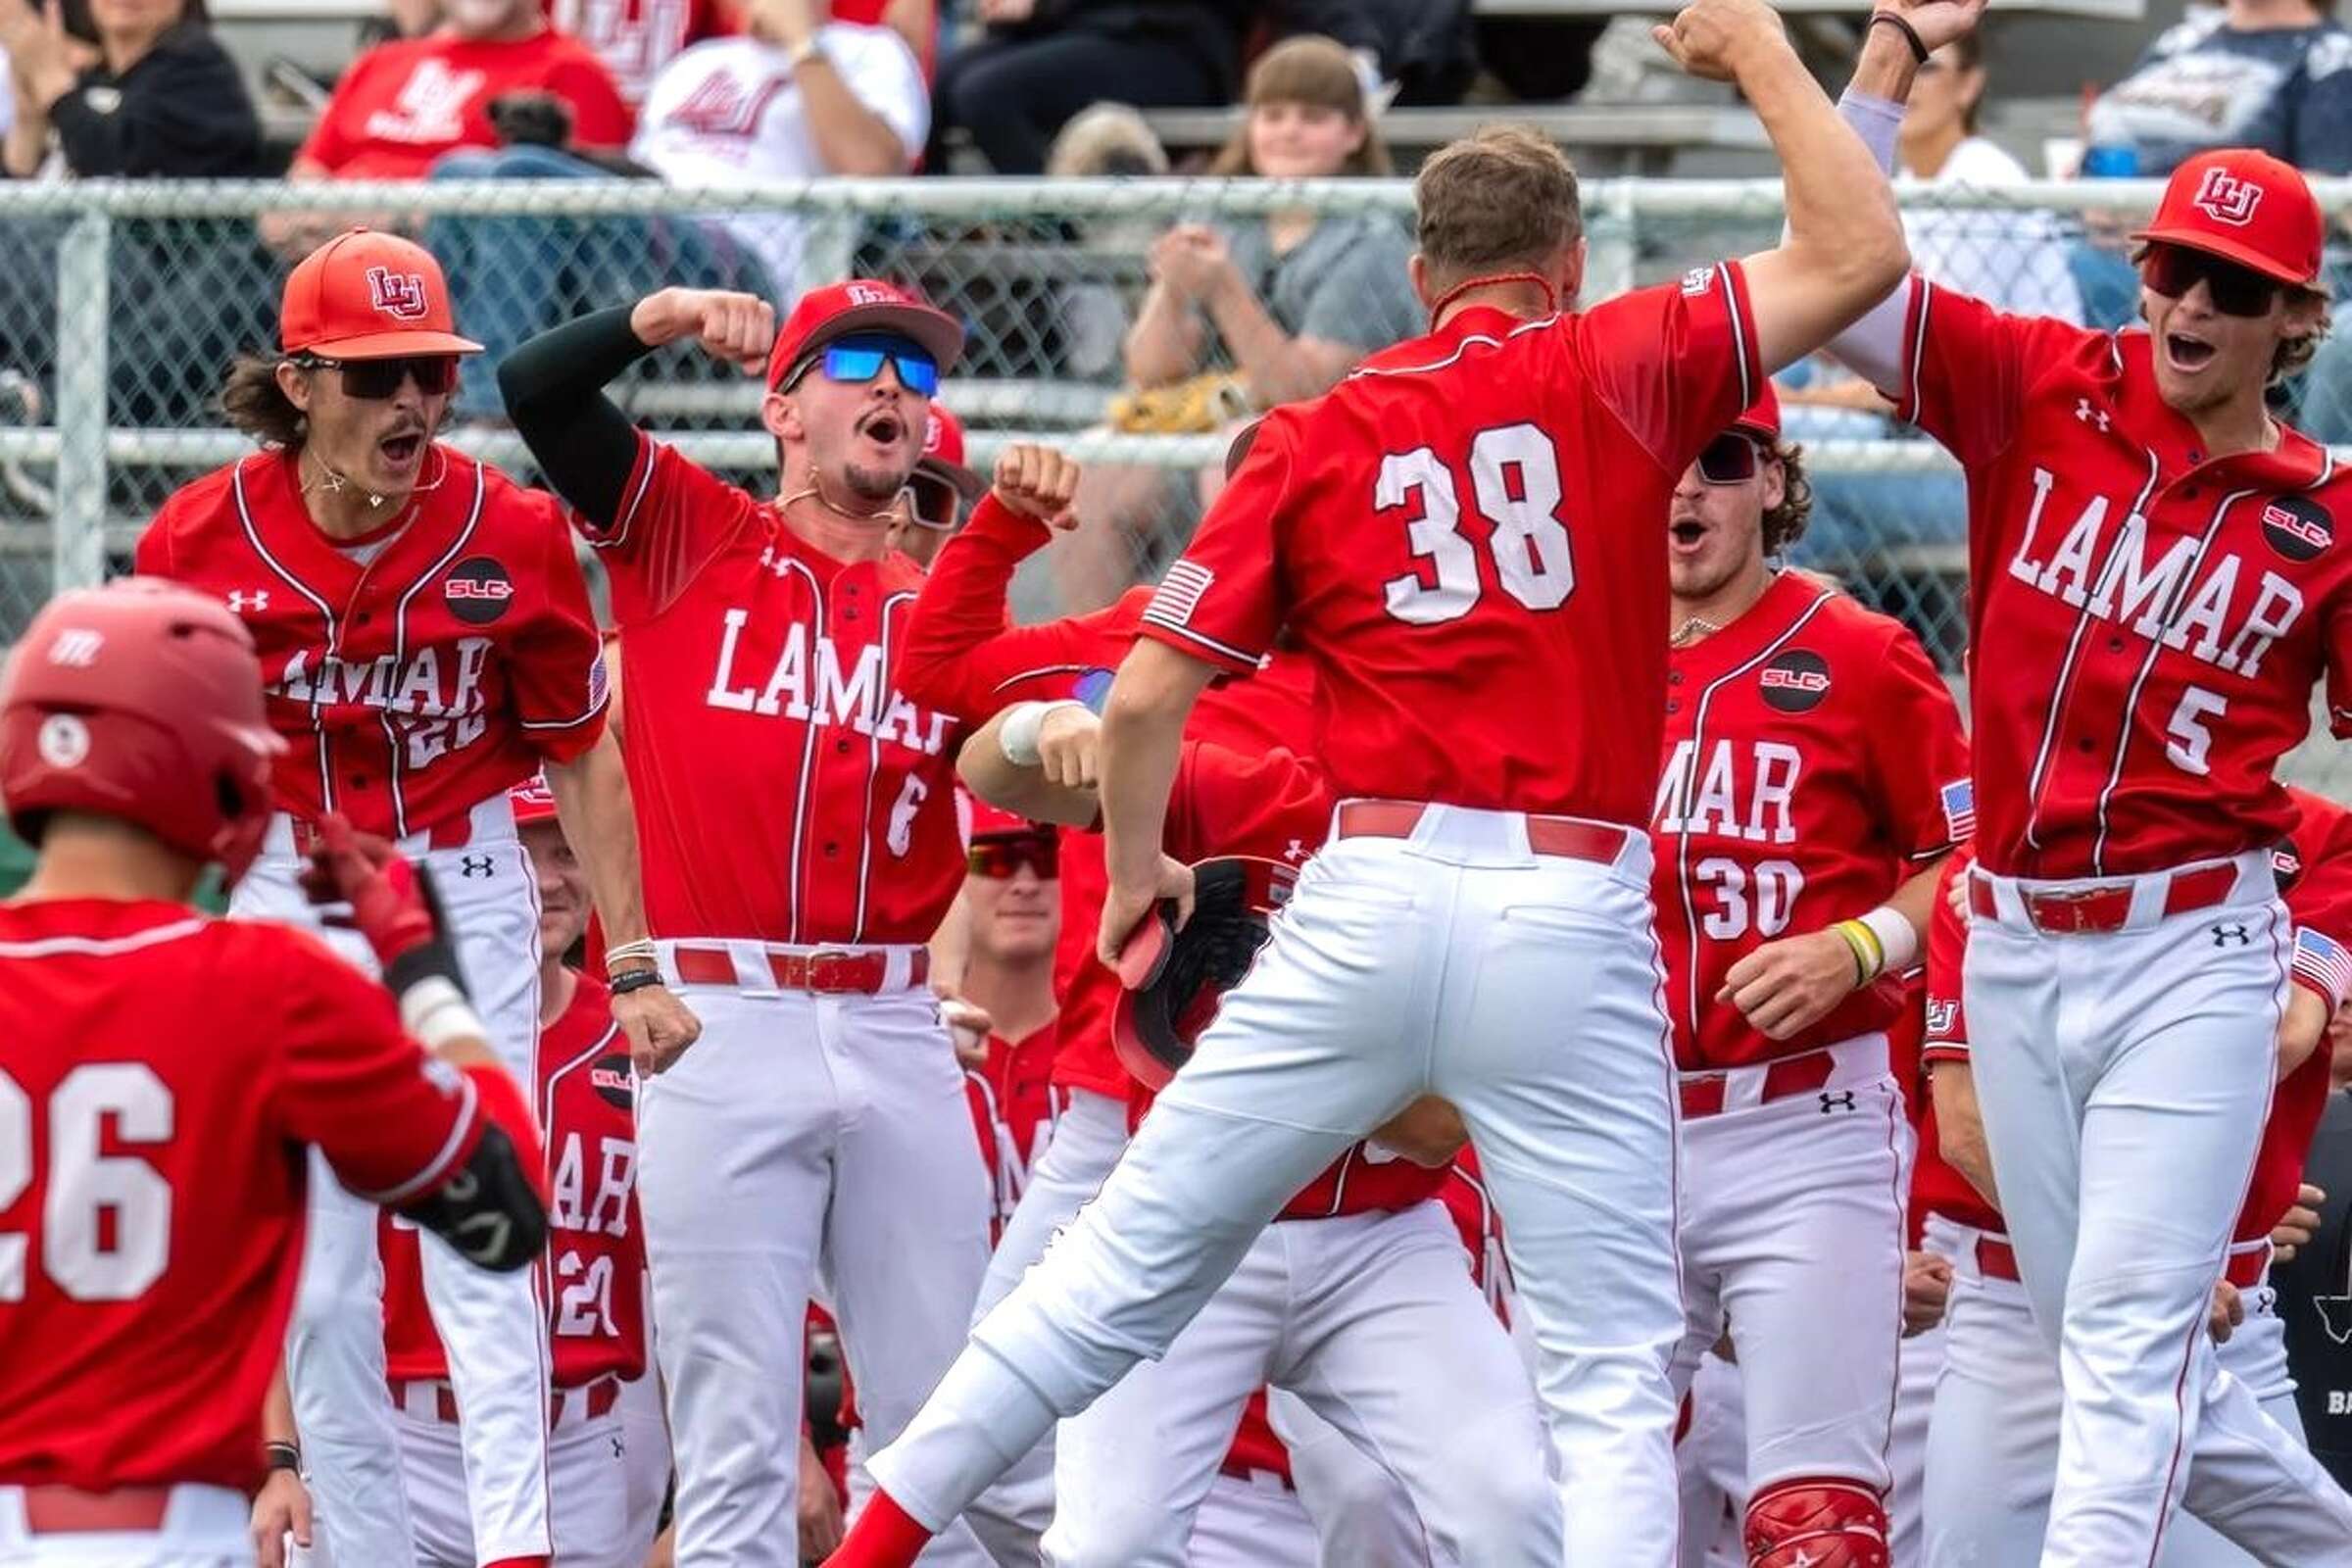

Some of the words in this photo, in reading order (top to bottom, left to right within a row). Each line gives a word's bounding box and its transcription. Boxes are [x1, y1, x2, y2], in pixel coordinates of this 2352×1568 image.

[2193, 167, 2264, 225] LU
[366, 266, 429, 320] LU
[1374, 421, 1576, 625] 38
[2262, 505, 2332, 549] SLC
[445, 579, 514, 599] SLC
[2008, 467, 2304, 679] LAMAR
[263, 638, 493, 718] AMAR
[1760, 667, 1831, 692] SLC
[2166, 686, 2228, 775] 5
[1695, 858, 1805, 941] 30
[0, 1061, 174, 1301] 6
